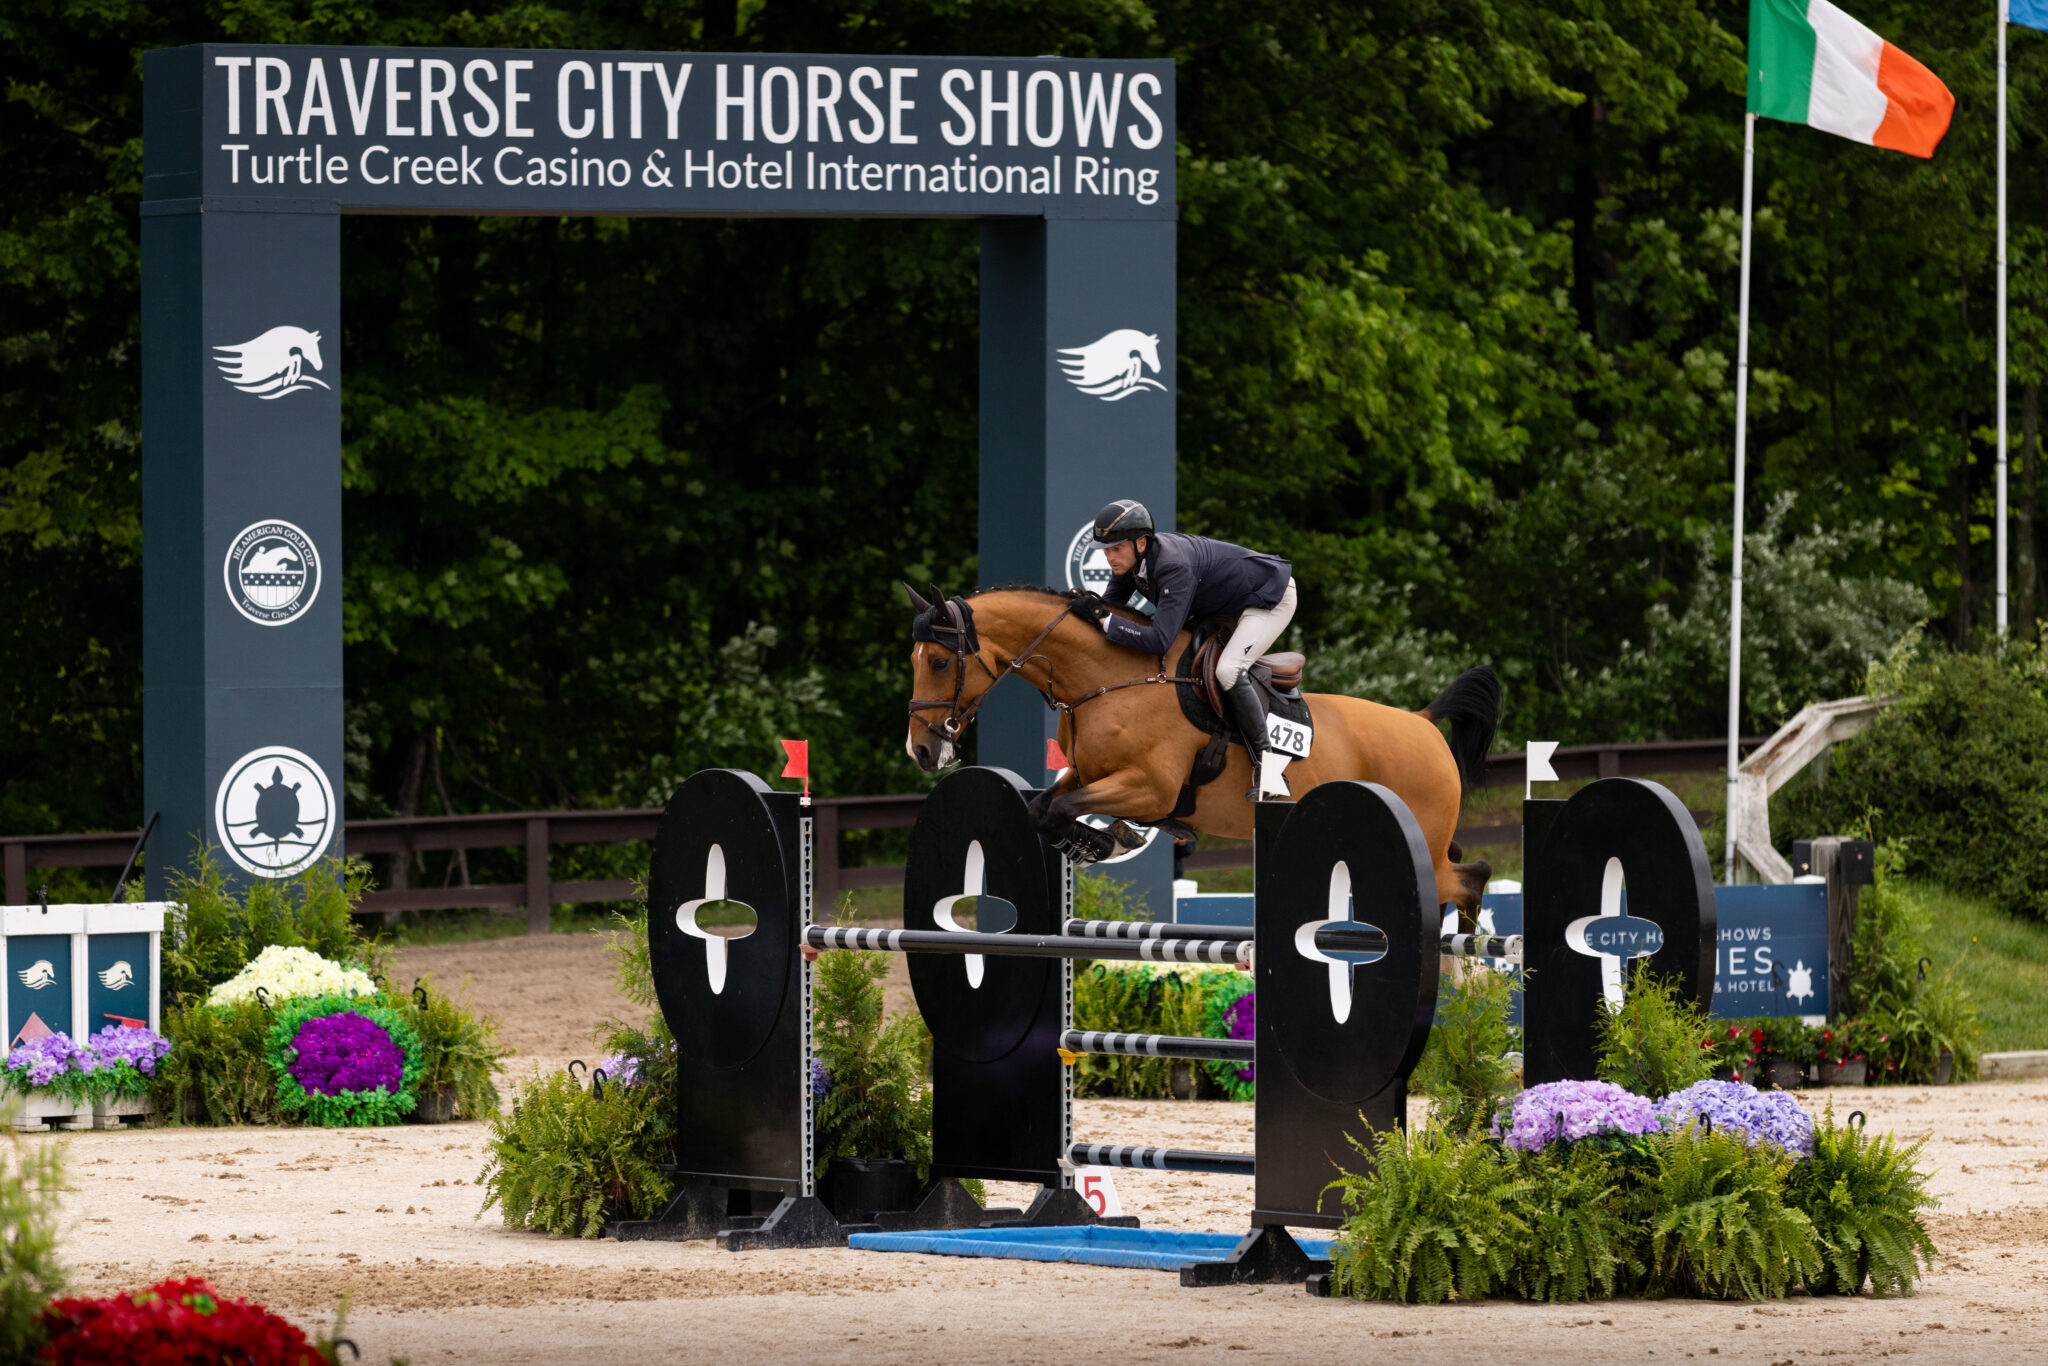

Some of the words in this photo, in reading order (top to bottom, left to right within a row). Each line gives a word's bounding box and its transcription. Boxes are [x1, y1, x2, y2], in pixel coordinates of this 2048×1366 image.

[215, 57, 534, 137] TRAVERSE
[558, 61, 692, 139] CITY
[716, 64, 918, 144] HORSE
[941, 69, 1162, 149] SHOWS
[221, 144, 348, 184] Turtle
[360, 145, 483, 184] Creek
[494, 147, 631, 186] Casino
[642, 149, 673, 187] &
[685, 150, 792, 189] Hotel
[808, 152, 1060, 194] International
[1075, 156, 1159, 205] Ring
[242, 526, 283, 548] AMERICAN
[284, 529, 306, 549] GOLD
[303, 548, 315, 567] CUP
[1270, 724, 1304, 752] 478
[1600, 931, 1638, 946] CITY
[1728, 979, 1775, 993] HOTEL
[1084, 1176, 1106, 1216] 5
